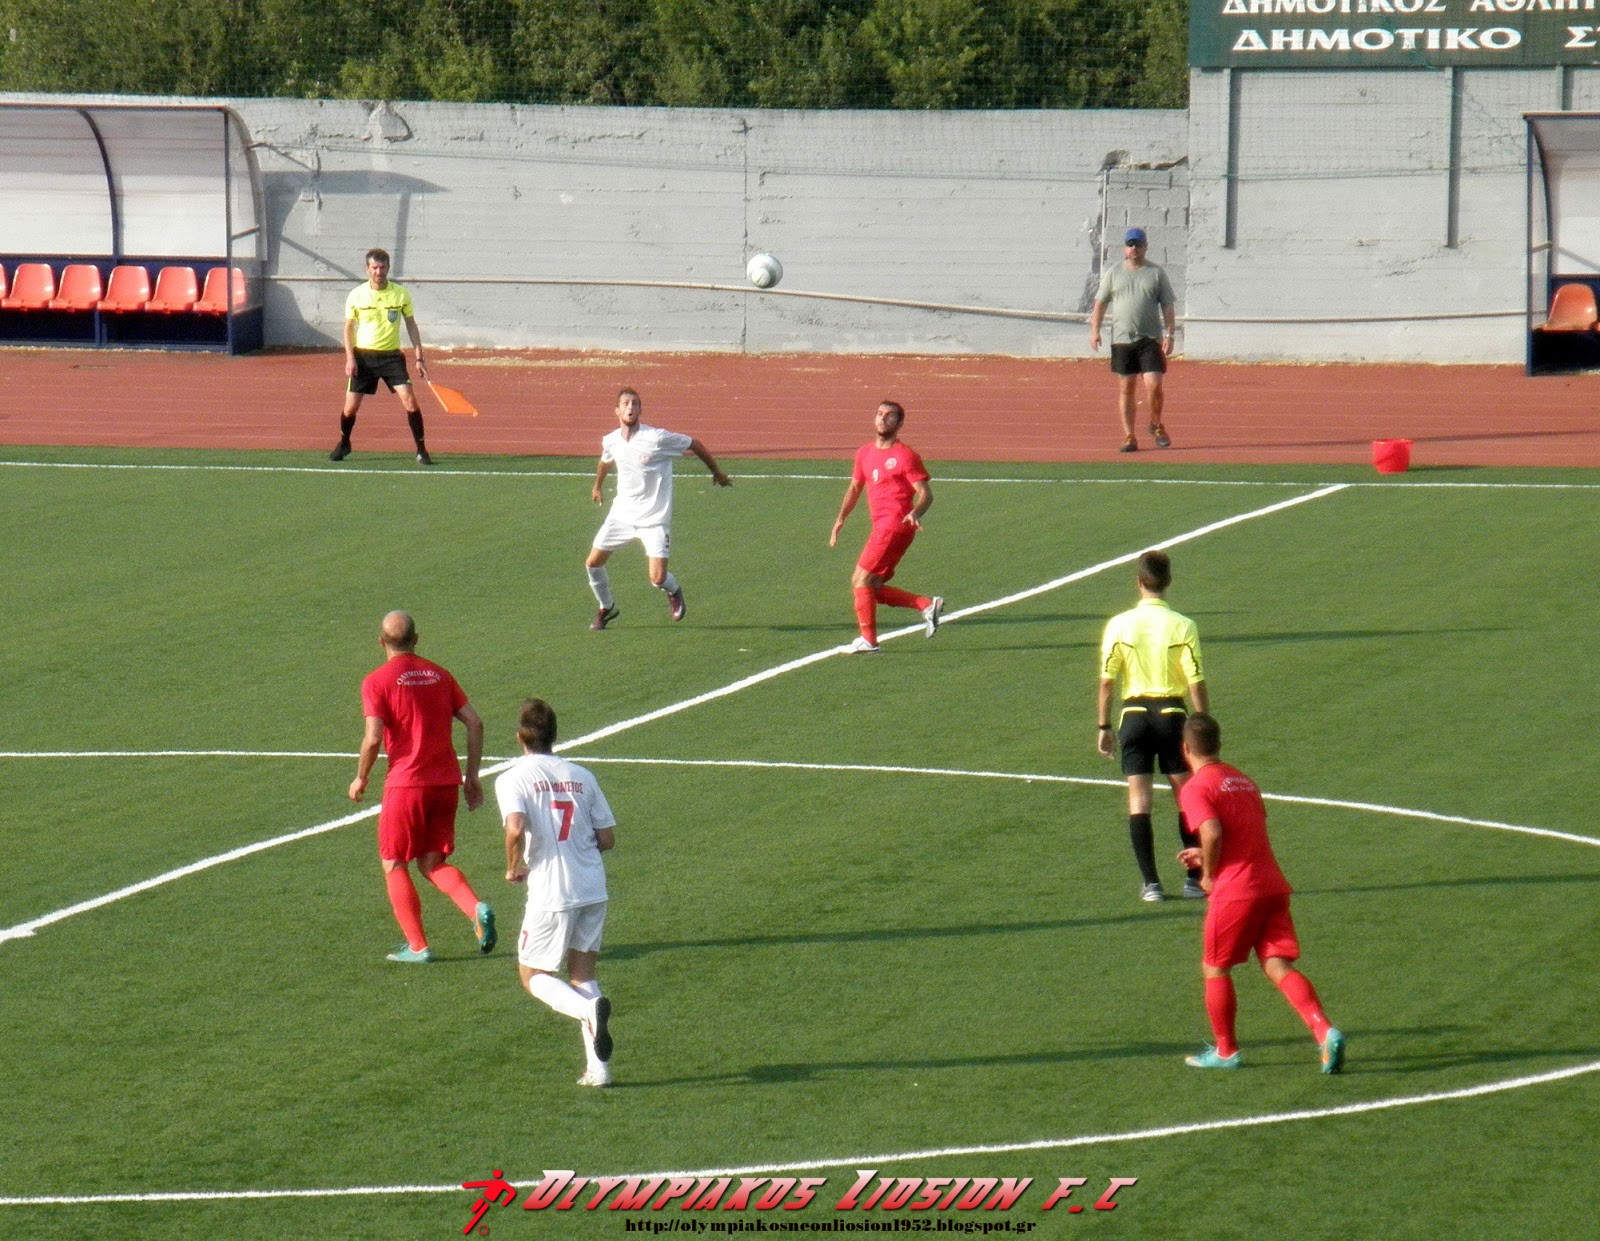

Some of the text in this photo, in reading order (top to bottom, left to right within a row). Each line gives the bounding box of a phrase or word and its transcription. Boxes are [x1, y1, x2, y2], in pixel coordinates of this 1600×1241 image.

[1231, 26, 1600, 51] ΔΗΜΟΤΙΚΟ Σ
[550, 799, 575, 842] 7
[521, 929, 529, 951] 7
